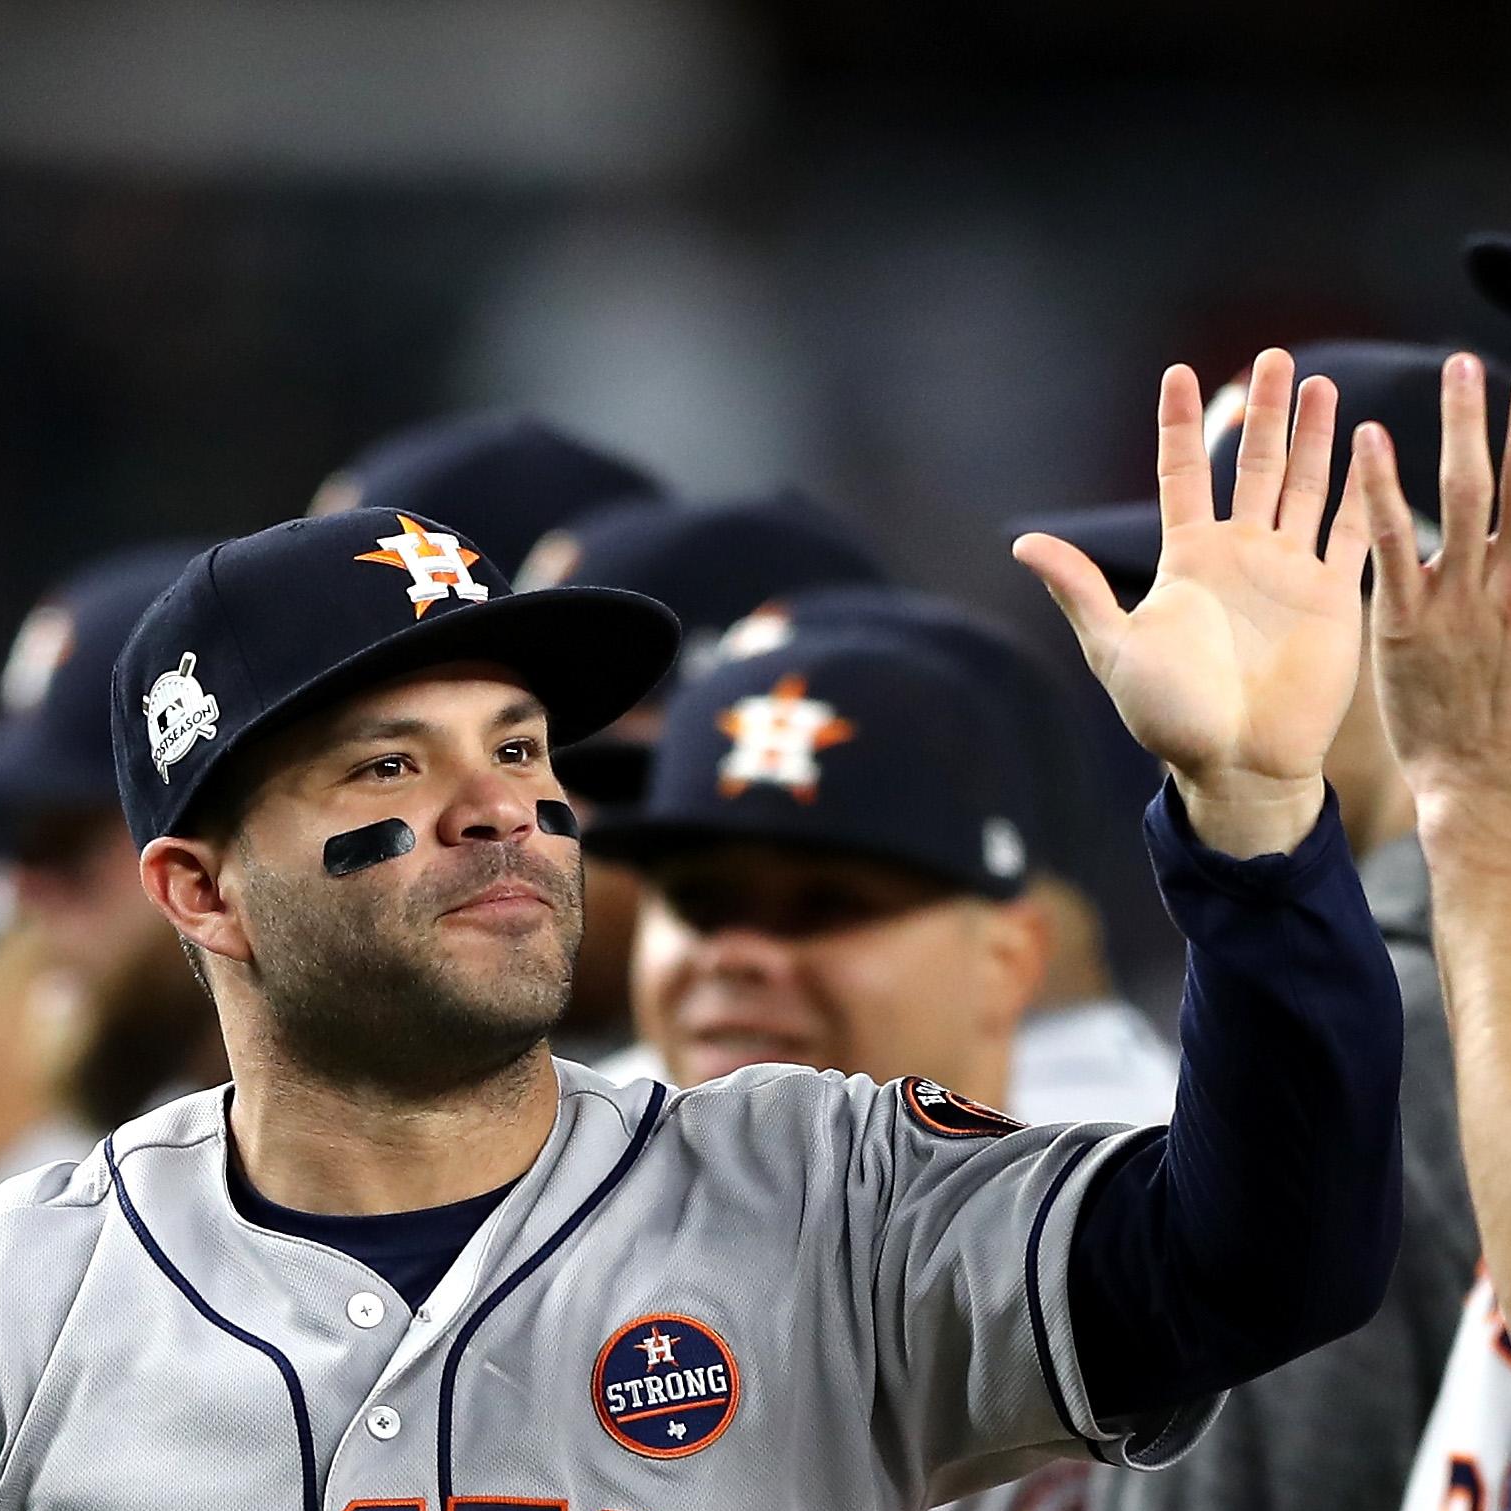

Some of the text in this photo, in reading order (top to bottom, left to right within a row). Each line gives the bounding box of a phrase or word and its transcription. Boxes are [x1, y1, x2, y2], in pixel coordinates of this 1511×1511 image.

[376, 532, 489, 603] H
[643, 1335, 675, 1365] H
[605, 1364, 728, 1413] STRONG
